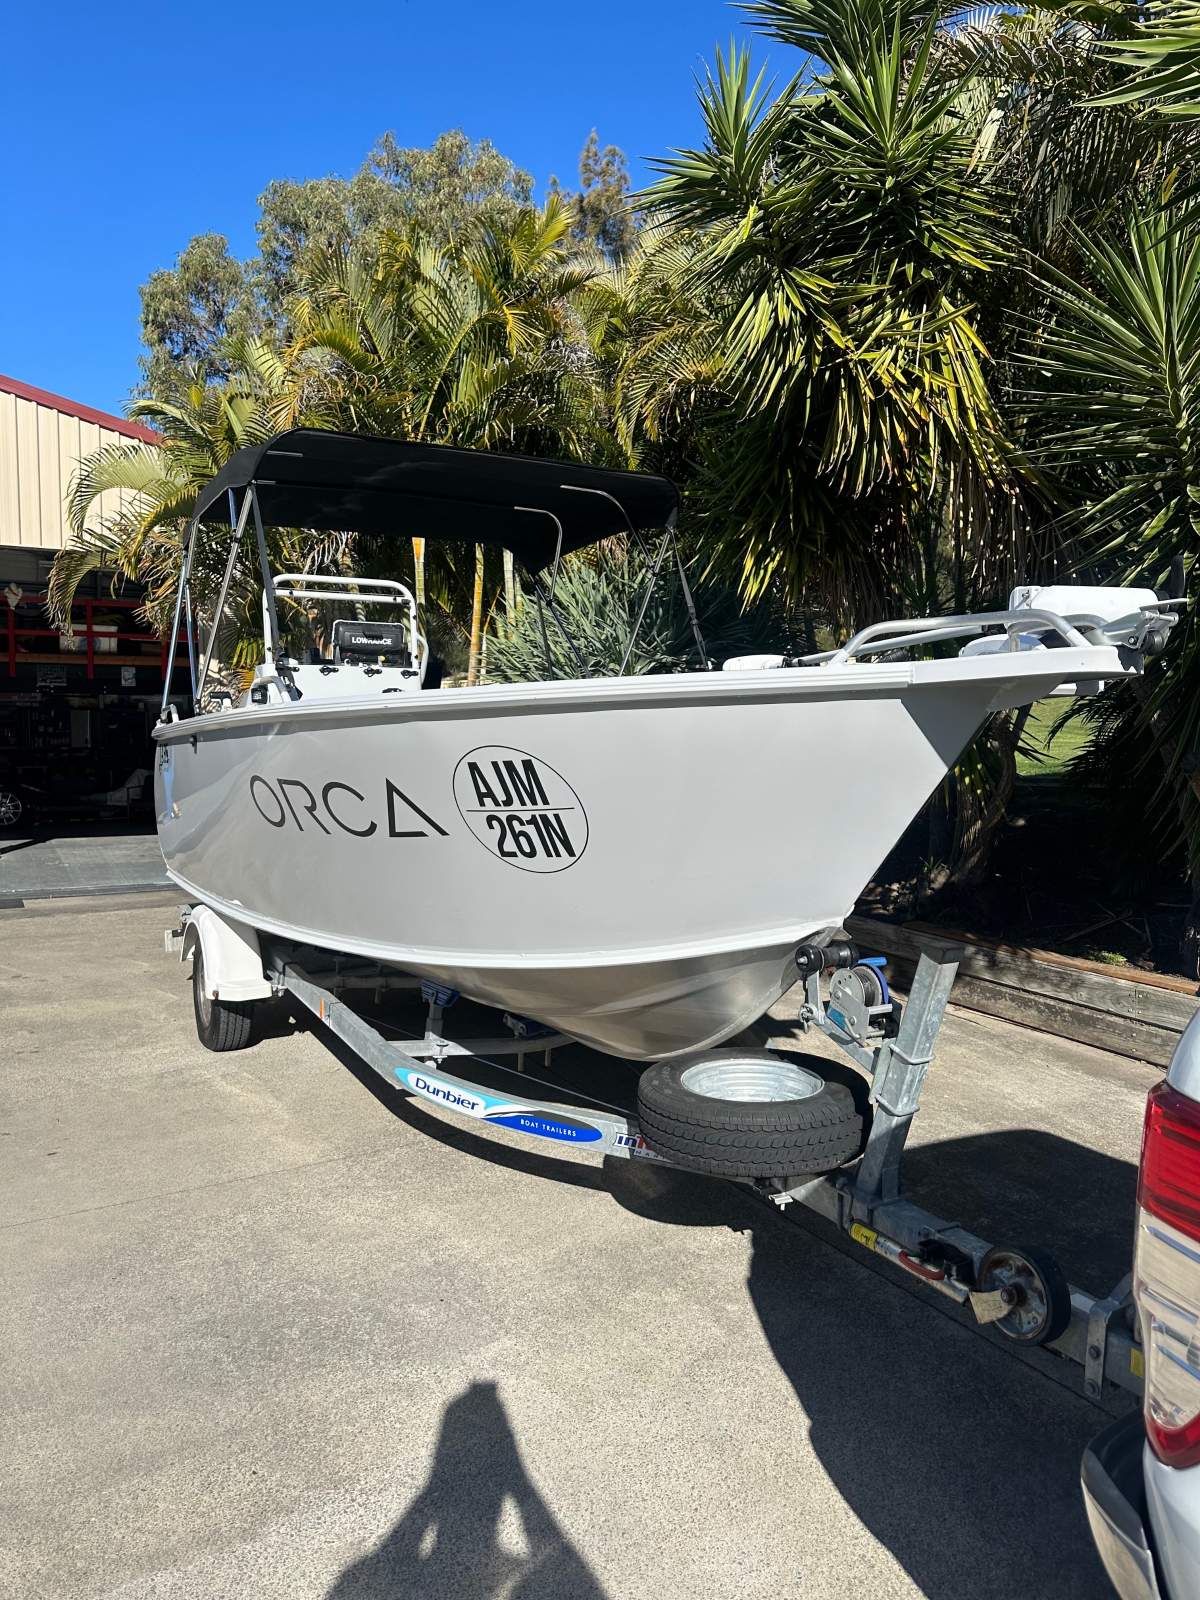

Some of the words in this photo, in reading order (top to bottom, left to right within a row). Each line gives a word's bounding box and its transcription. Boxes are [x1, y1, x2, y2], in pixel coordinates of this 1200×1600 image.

[467, 759, 550, 807] AJM
[250, 774, 450, 838] ORCA
[486, 813, 577, 858] 261N
[415, 1077, 479, 1111] Dunbier
[520, 1118, 539, 1129] BOAT
[542, 1123, 577, 1137] TRAILERS
